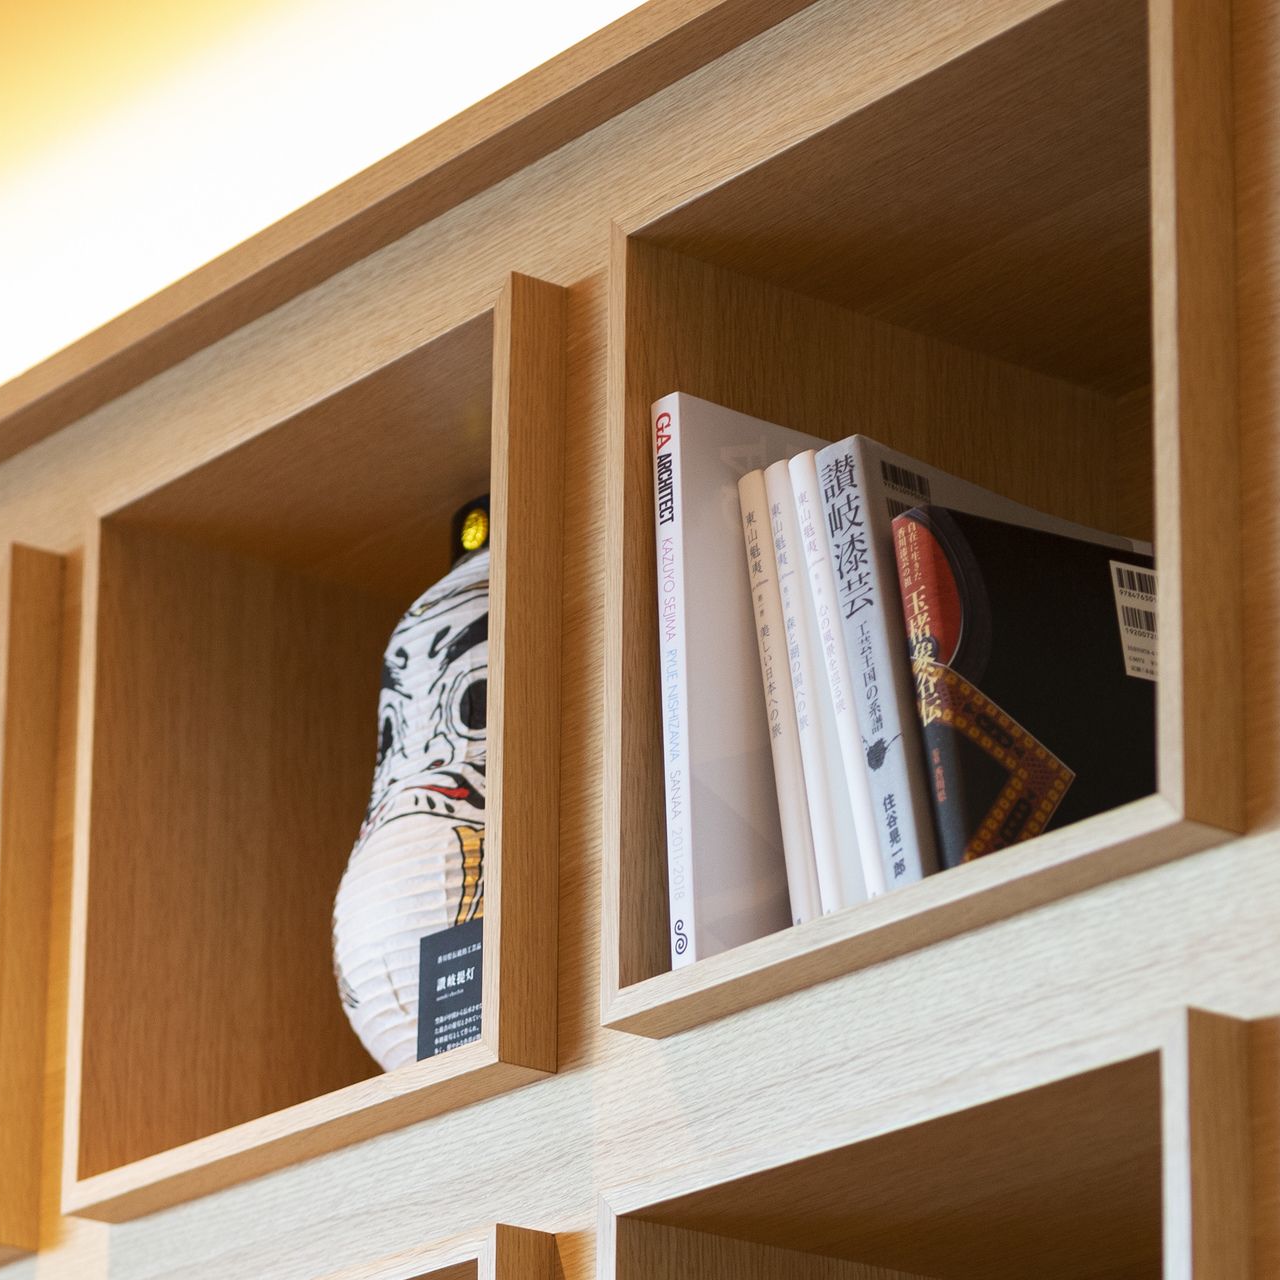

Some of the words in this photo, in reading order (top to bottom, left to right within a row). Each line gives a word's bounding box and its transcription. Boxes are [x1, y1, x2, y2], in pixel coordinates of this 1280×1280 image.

[655, 411, 673, 454] GA
[657, 452, 675, 526] ARCHITECT
[662, 537, 676, 593] KAZUYO
[907, 521, 923, 582] 自在に生きた
[663, 596, 677, 642] SEJIMA
[744, 510, 764, 578] 東山魁夷
[760, 623, 783, 739] 美しい日本への旅
[665, 648, 679, 682] RYUE
[821, 453, 874, 620] 讃岐漆芸
[857, 620, 884, 735] 工芸王国の系譜
[883, 793, 906, 879] 住谷晃一郎
[667, 684, 681, 763] NISHIZAWA
[670, 769, 682, 821] SANAA
